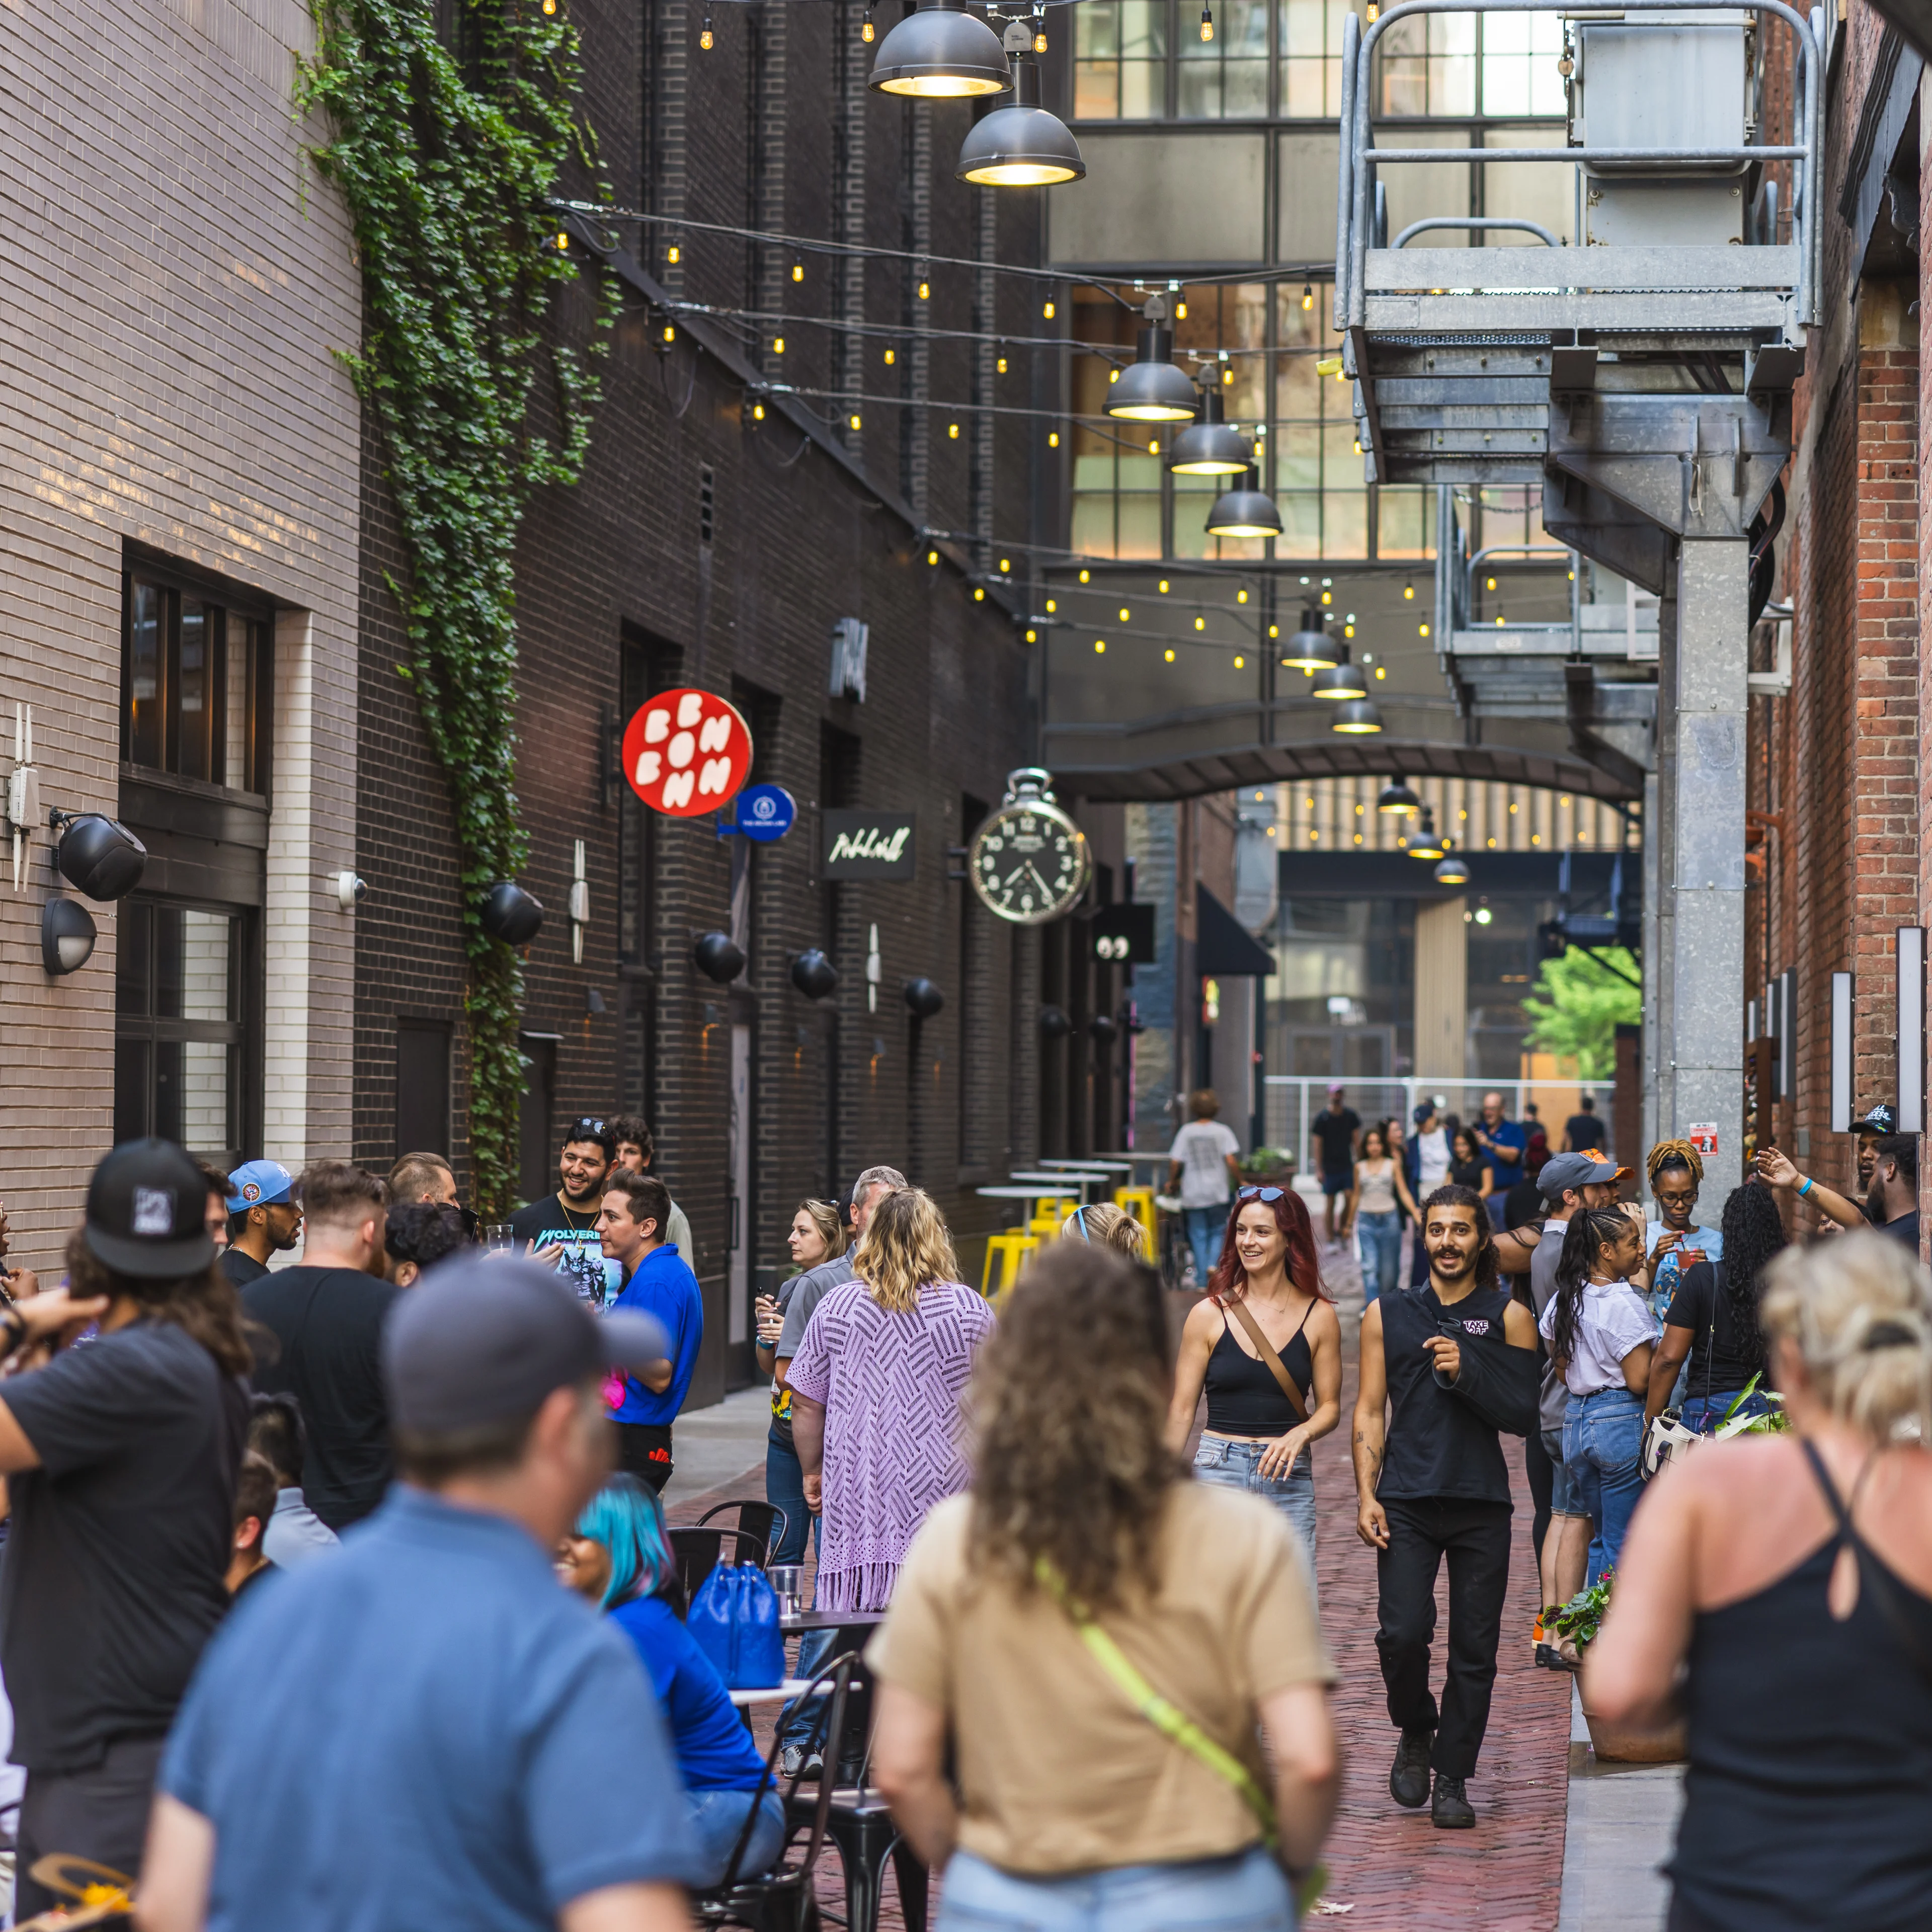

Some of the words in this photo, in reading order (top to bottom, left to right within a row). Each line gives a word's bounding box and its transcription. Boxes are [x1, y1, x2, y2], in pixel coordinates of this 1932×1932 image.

[1002, 822, 1015, 836] 11
[1019, 816, 1036, 831] 12
[1044, 822, 1052, 836] 1
[987, 836, 1003, 851] 10
[1056, 836, 1067, 851] 2
[983, 855, 995, 871] 9
[1060, 855, 1072, 871] 3
[988, 874, 1000, 891] 8
[1055, 874, 1067, 891] 4
[1002, 889, 1014, 905] 7
[1020, 894, 1033, 909] 6
[1868, 1110, 1889, 1118] CCESS
[533, 1229, 600, 1253] WOLVERI
[1464, 1321, 1488, 1329] TAKE
